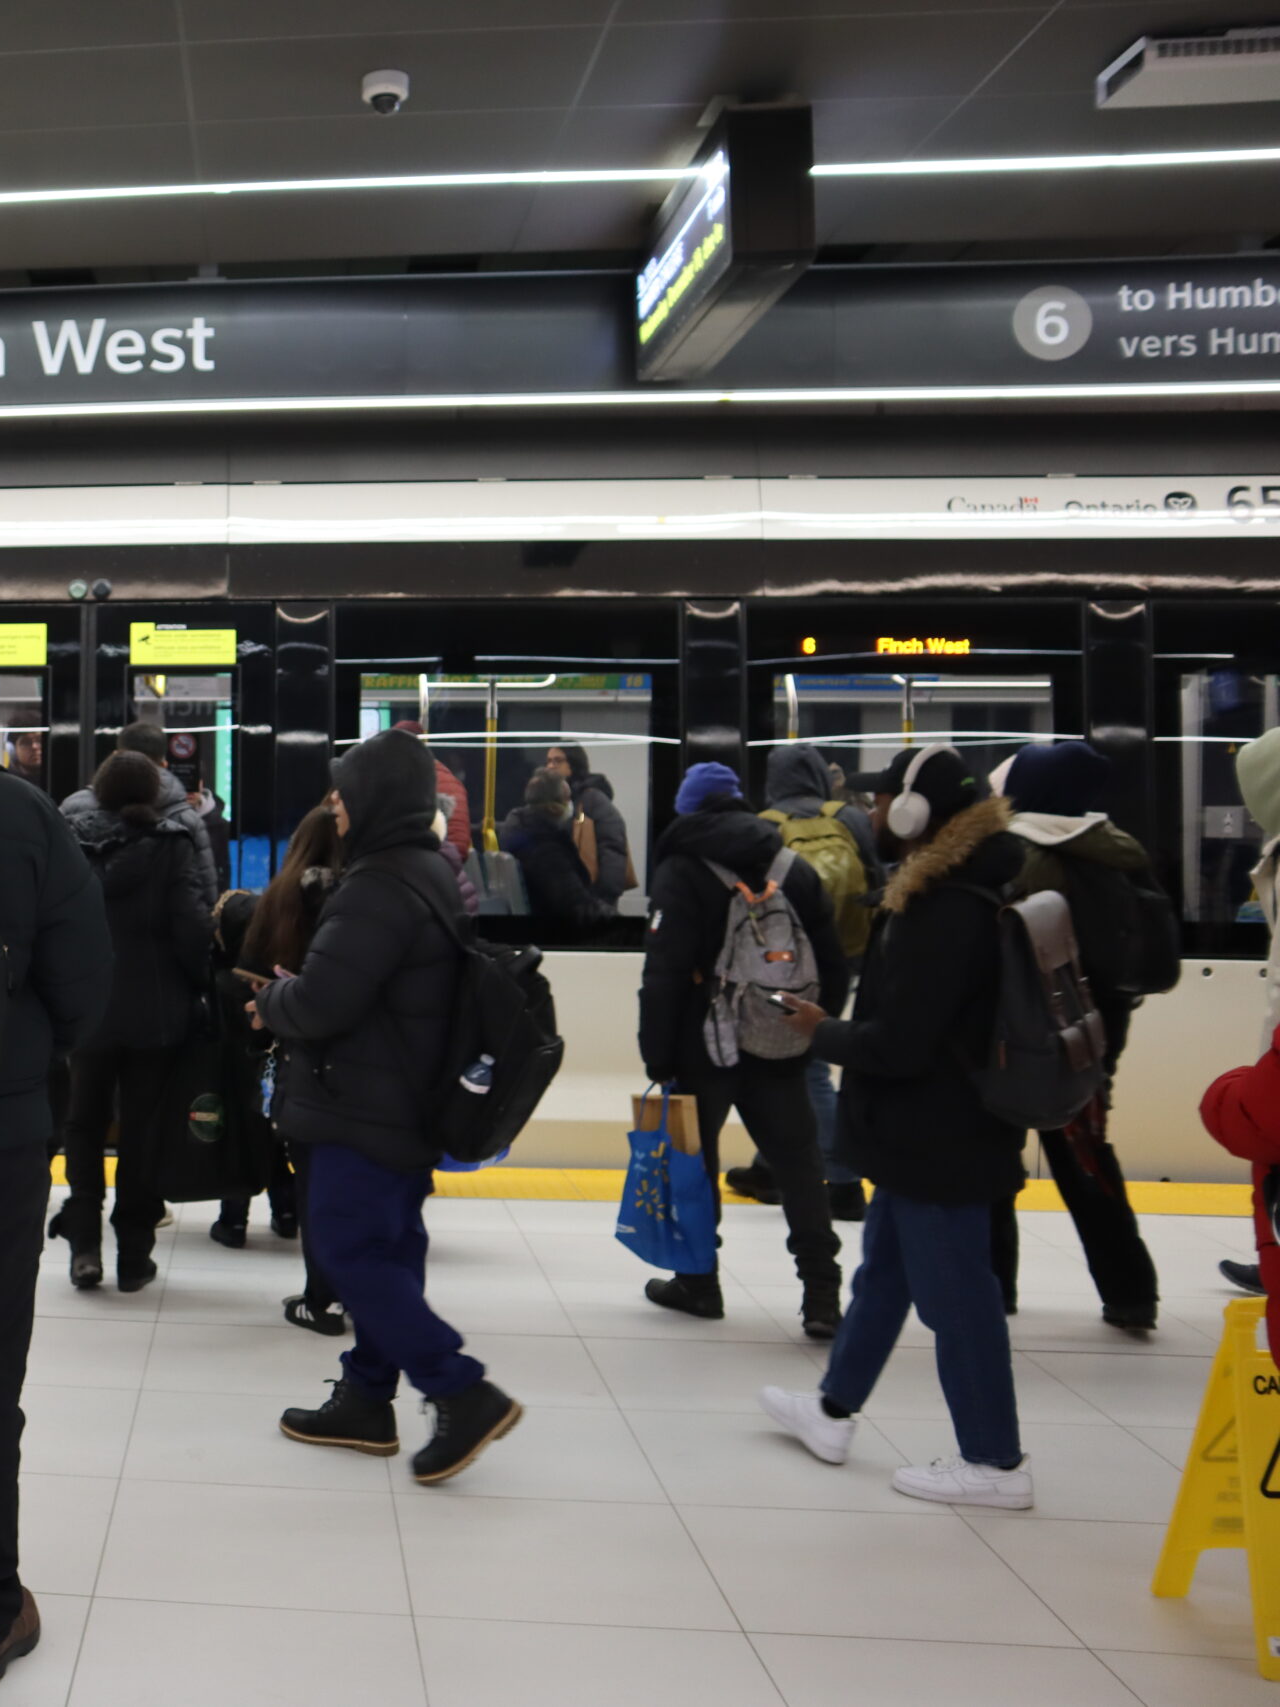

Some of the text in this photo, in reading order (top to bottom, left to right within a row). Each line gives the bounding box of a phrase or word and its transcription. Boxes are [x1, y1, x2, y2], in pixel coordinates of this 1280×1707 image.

[1118, 278, 1280, 312] to Humb
[1035, 300, 1070, 346] 6
[31, 317, 216, 376] West
[1119, 333, 1198, 358] vers
[1064, 500, 1158, 516] Ontario
[802, 637, 970, 655] 6 Finch West
[1253, 1375, 1280, 1395] CA
